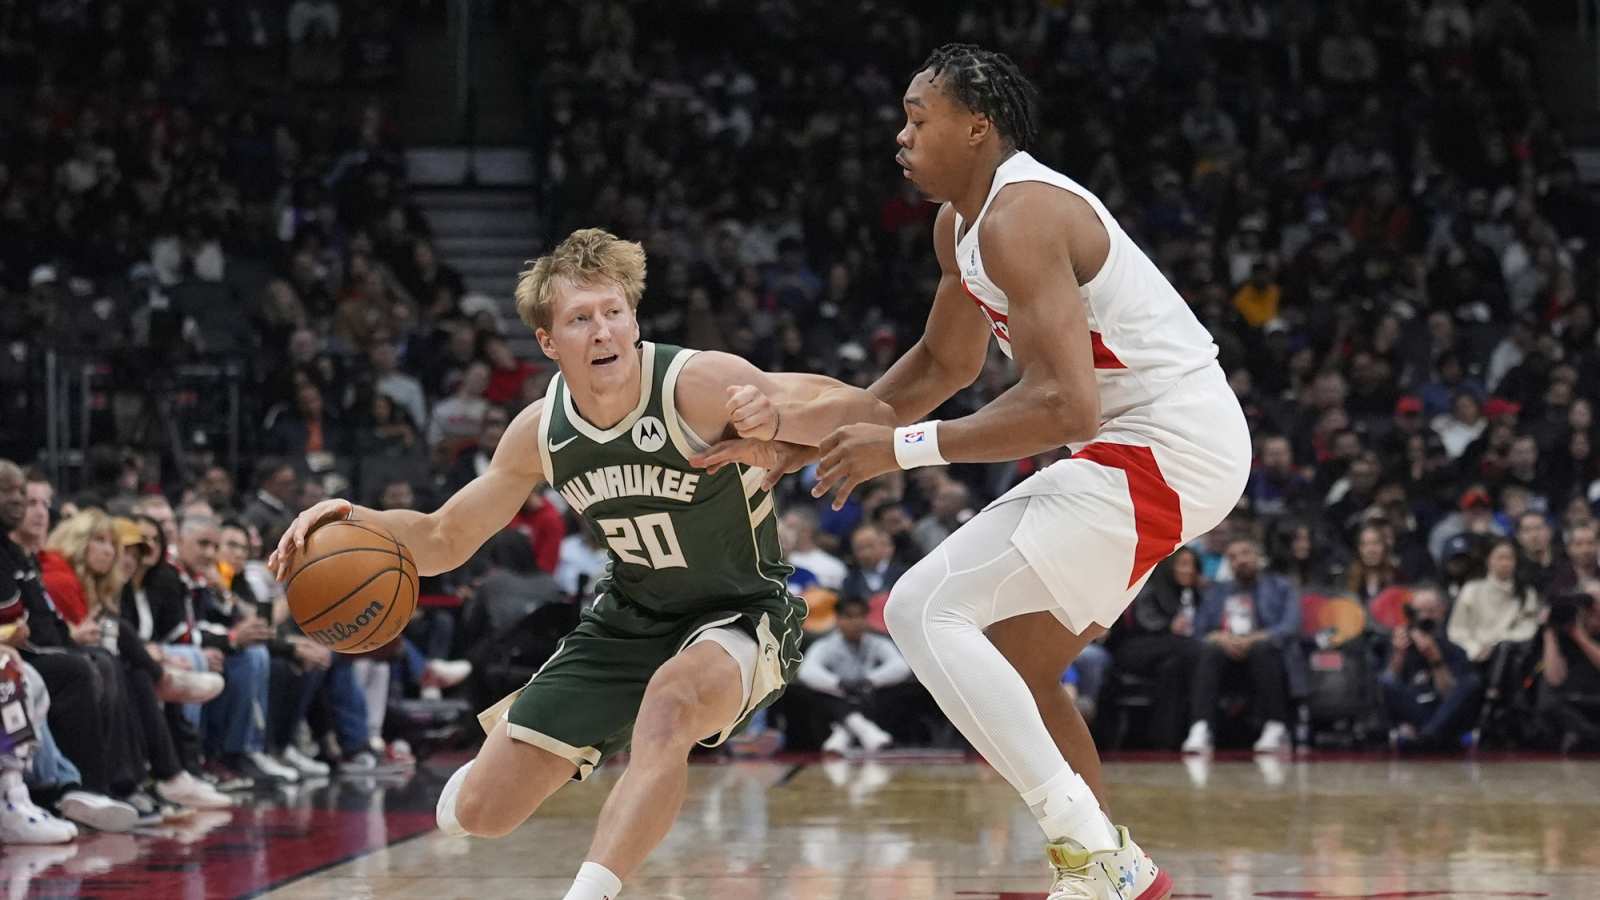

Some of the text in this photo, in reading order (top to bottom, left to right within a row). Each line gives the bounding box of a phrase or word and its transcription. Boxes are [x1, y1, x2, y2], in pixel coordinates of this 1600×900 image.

[560, 464, 700, 516] MILWAUKEE
[597, 512, 688, 570] 20
[307, 599, 385, 646] Wilson
